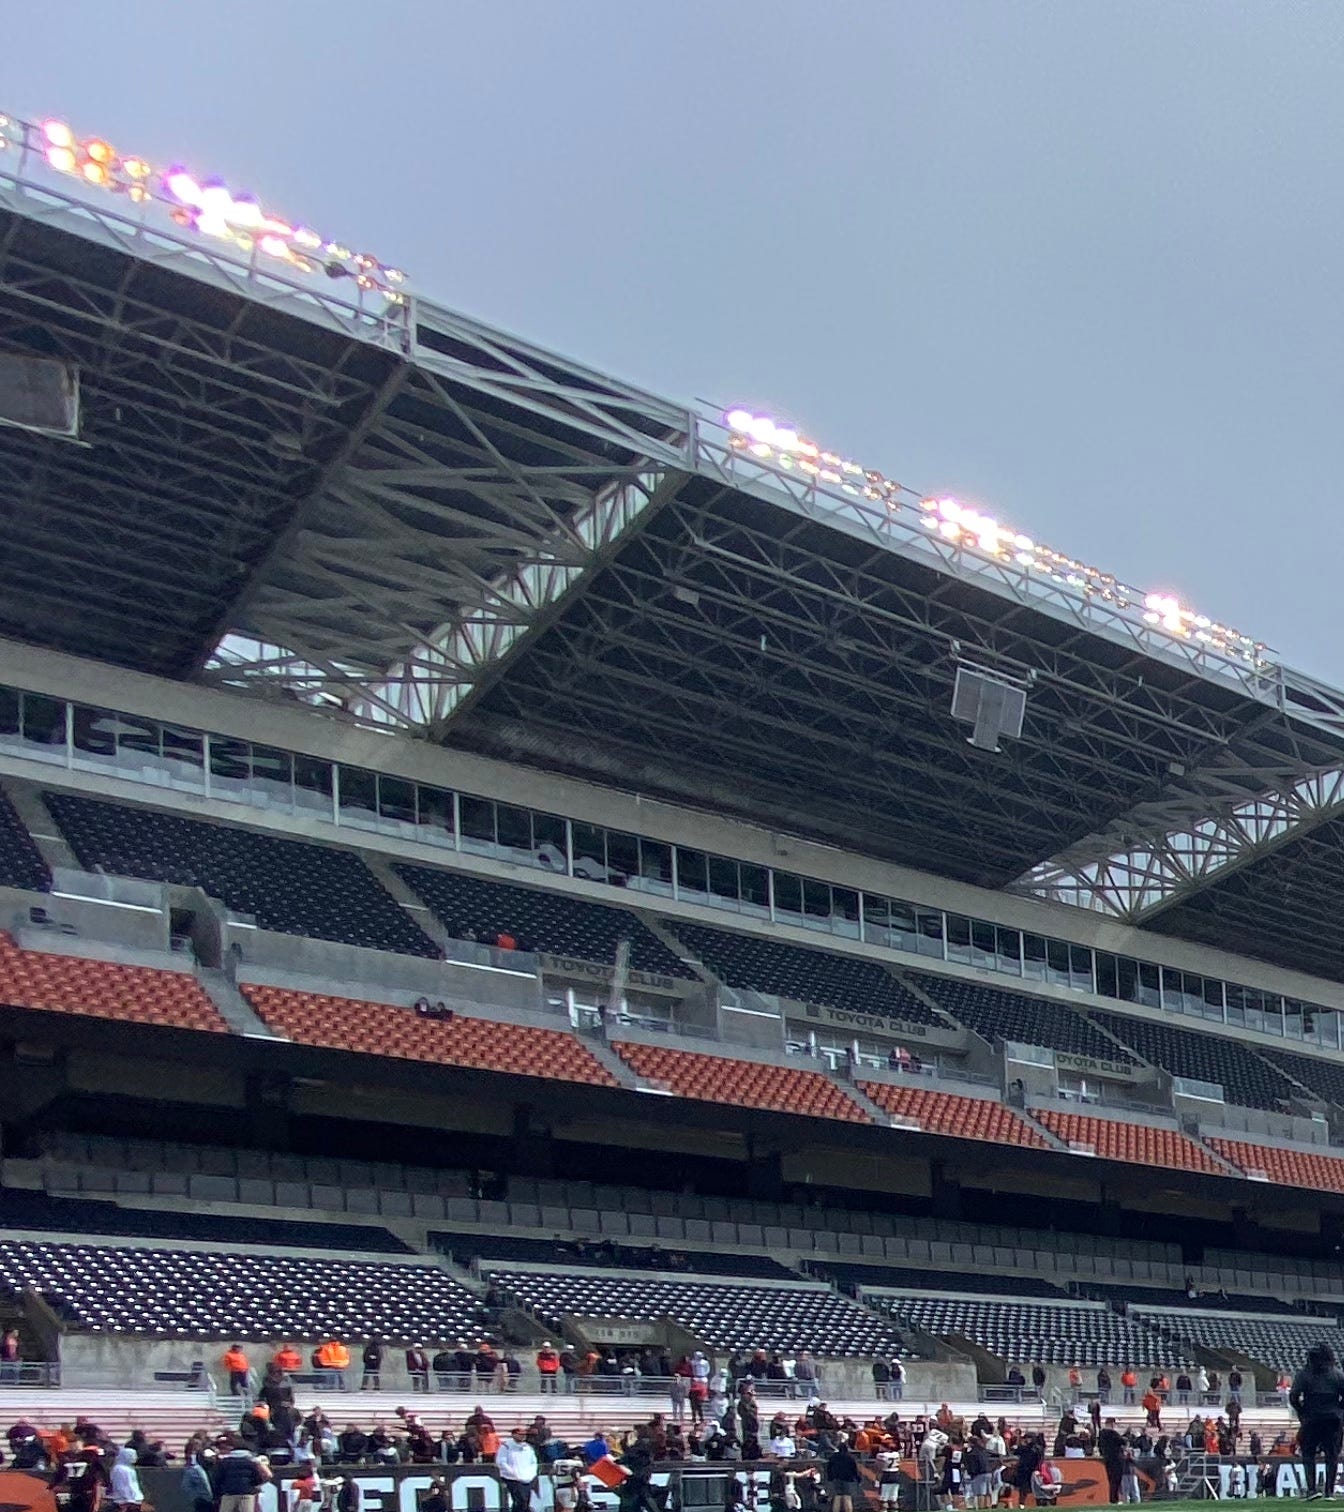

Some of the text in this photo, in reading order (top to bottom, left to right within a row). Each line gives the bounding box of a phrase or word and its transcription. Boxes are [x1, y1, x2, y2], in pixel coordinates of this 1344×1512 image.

[549, 957, 674, 989] TOYOT CLUB
[825, 1008, 926, 1036] TOYOTA CLUB
[1056, 1054, 1132, 1075] OYOTA CLUB
[63, 1462, 88, 1478] 17
